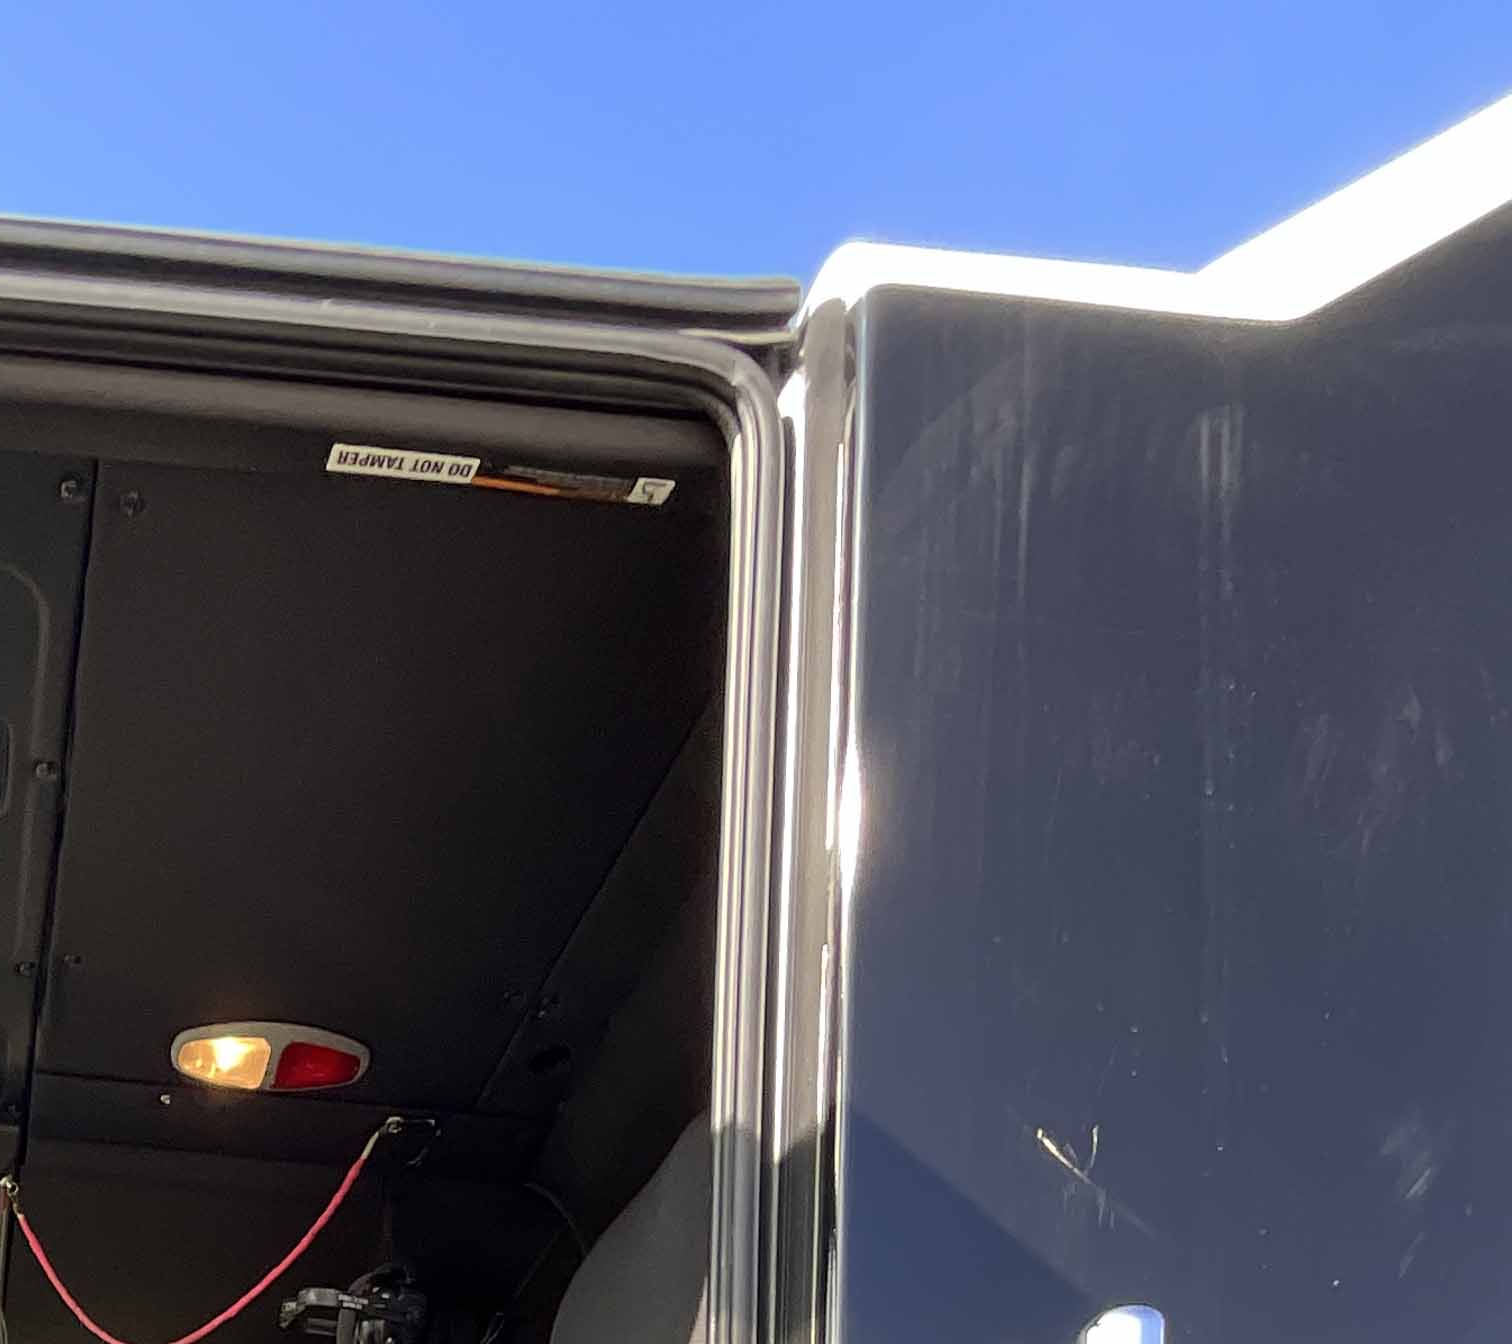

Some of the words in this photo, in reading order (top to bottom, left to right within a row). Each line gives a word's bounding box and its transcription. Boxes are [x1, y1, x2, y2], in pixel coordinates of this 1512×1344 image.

[337, 450, 405, 471] TAMPER
[409, 458, 444, 474] NOT
[448, 463, 473, 477] DO
